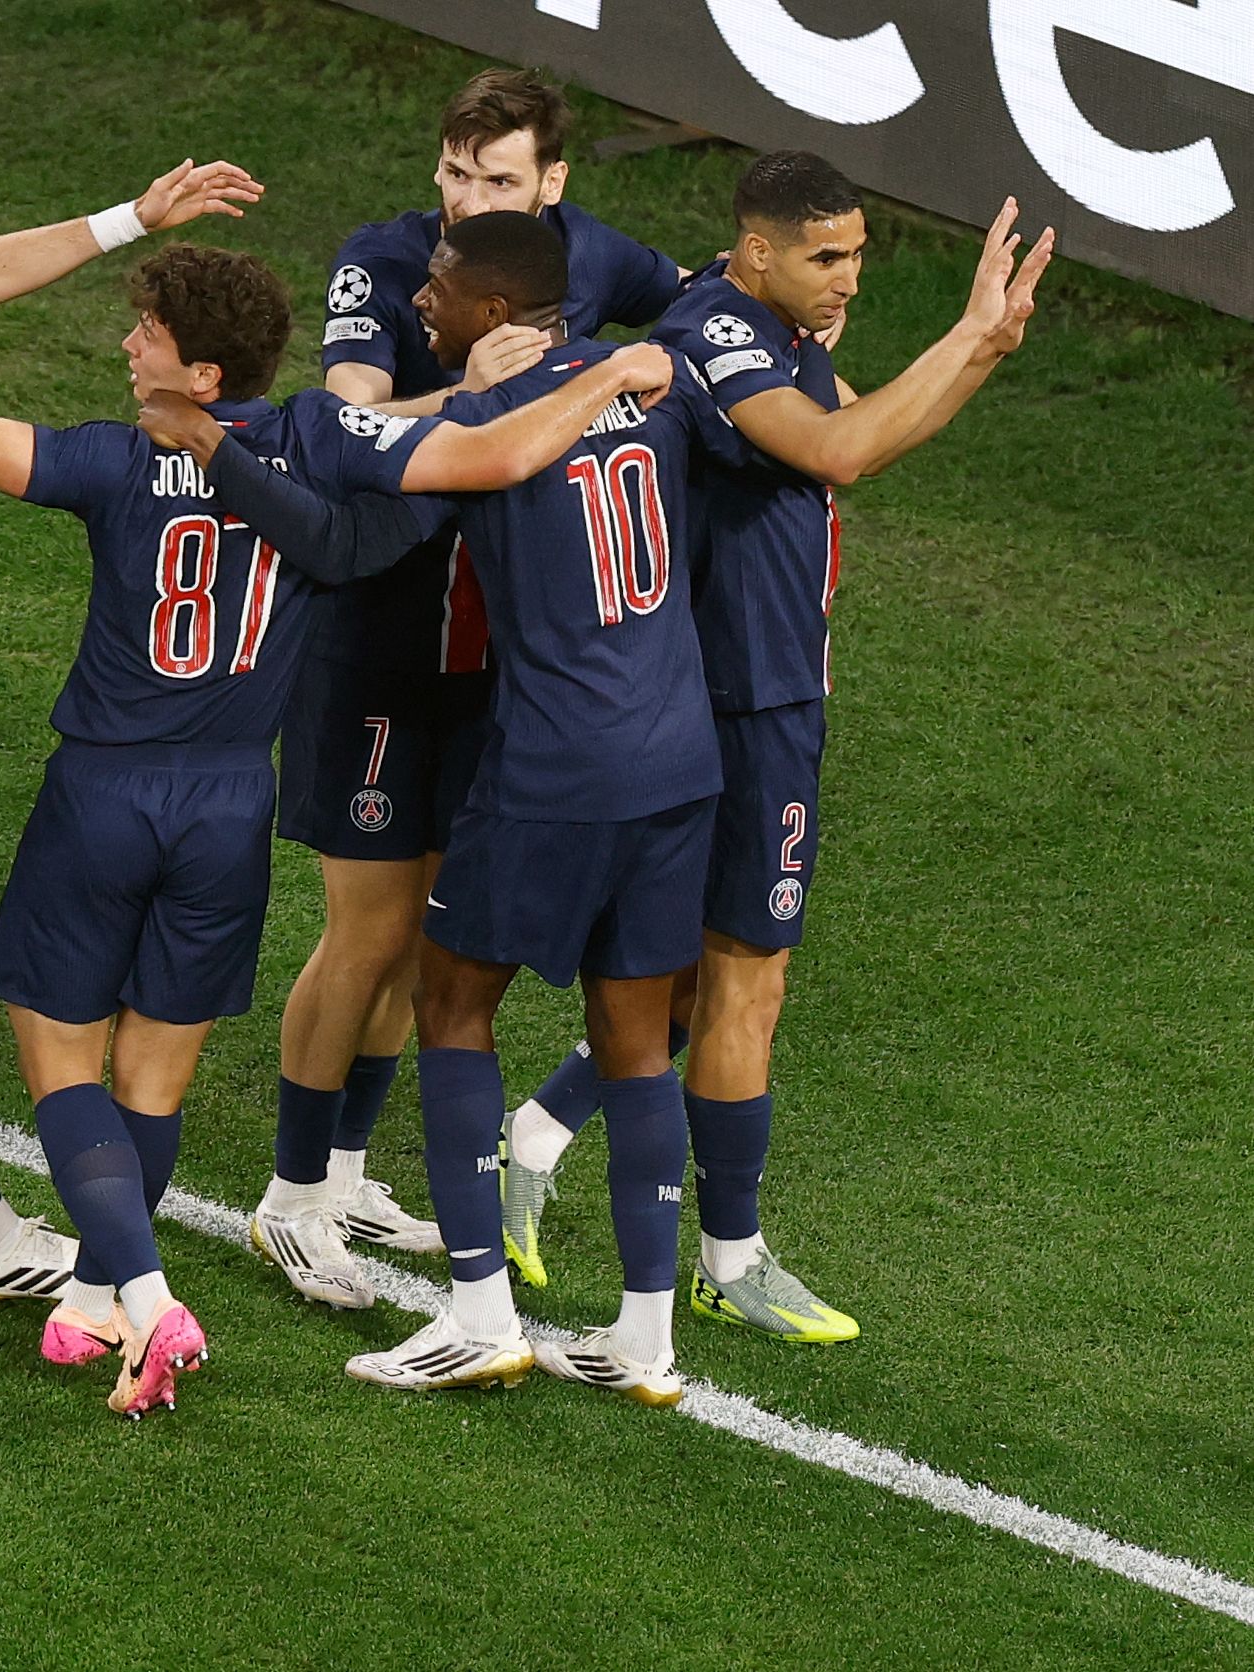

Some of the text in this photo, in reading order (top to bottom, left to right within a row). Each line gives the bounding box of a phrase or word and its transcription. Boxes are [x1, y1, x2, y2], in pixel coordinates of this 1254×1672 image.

[567, 442, 670, 627] 10
[148, 514, 282, 679] 87
[364, 716, 390, 786] 7
[780, 802, 806, 872] 2
